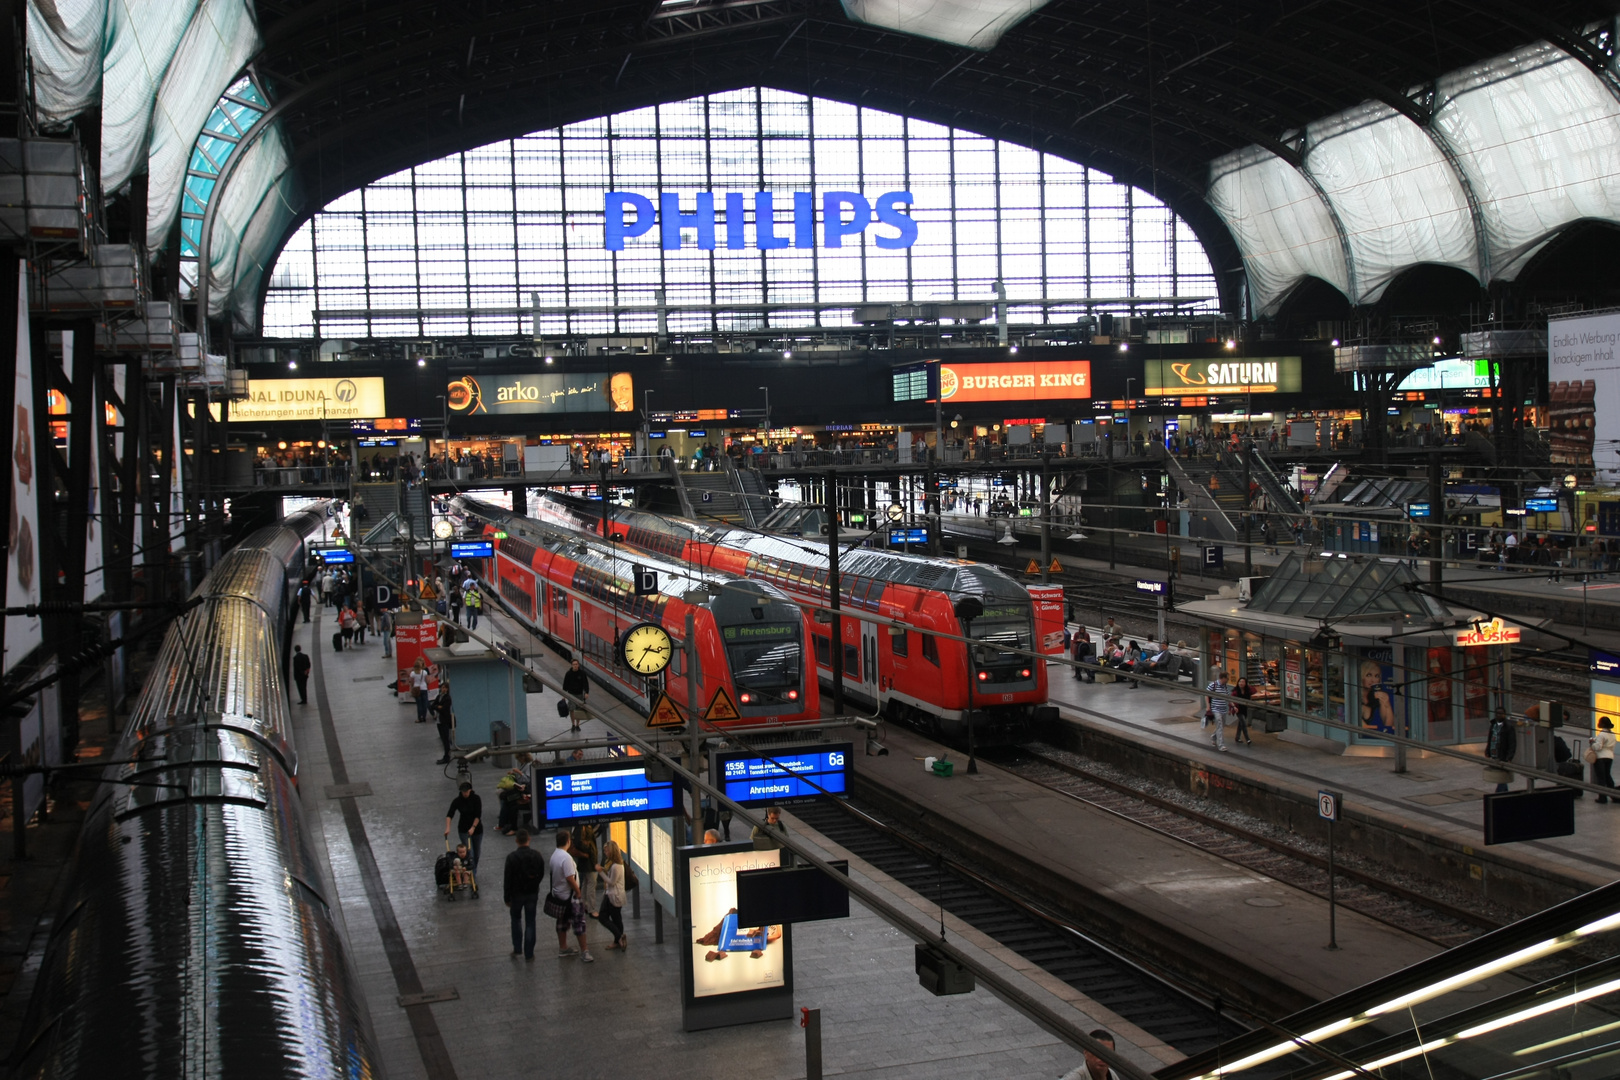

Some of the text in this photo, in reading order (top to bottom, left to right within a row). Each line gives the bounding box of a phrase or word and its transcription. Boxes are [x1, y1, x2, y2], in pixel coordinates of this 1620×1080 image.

[604, 191, 919, 250] PHILIPS
[1553, 333, 1578, 348] Endlich
[1579, 330, 1616, 346] Werbung
[1553, 351, 1592, 366] knackigem
[962, 373, 1085, 389] BURGER KING
[1207, 362, 1278, 385] SATURN
[280, 390, 325, 402] IDUNA
[497, 381, 539, 401] arko
[228, 407, 359, 418] ersicherungen und Fnanzen
[702, 493, 709, 501] D
[1467, 533, 1476, 549] E
[1206, 547, 1216, 564] E
[642, 572, 655, 590] D
[1136, 580, 1154, 592] Hamburg
[377, 585, 390, 604] D
[740, 626, 791, 636] Ahrensburg
[1467, 631, 1510, 644] KIOSK
[1367, 649, 1393, 661] Coffe
[725, 762, 745, 771] 15:56
[829, 752, 845, 766] 6a
[545, 777, 563, 791] 5a
[749, 784, 790, 795] Ahrensburg
[572, 798, 648, 812] Bitte nicht einsteigen
